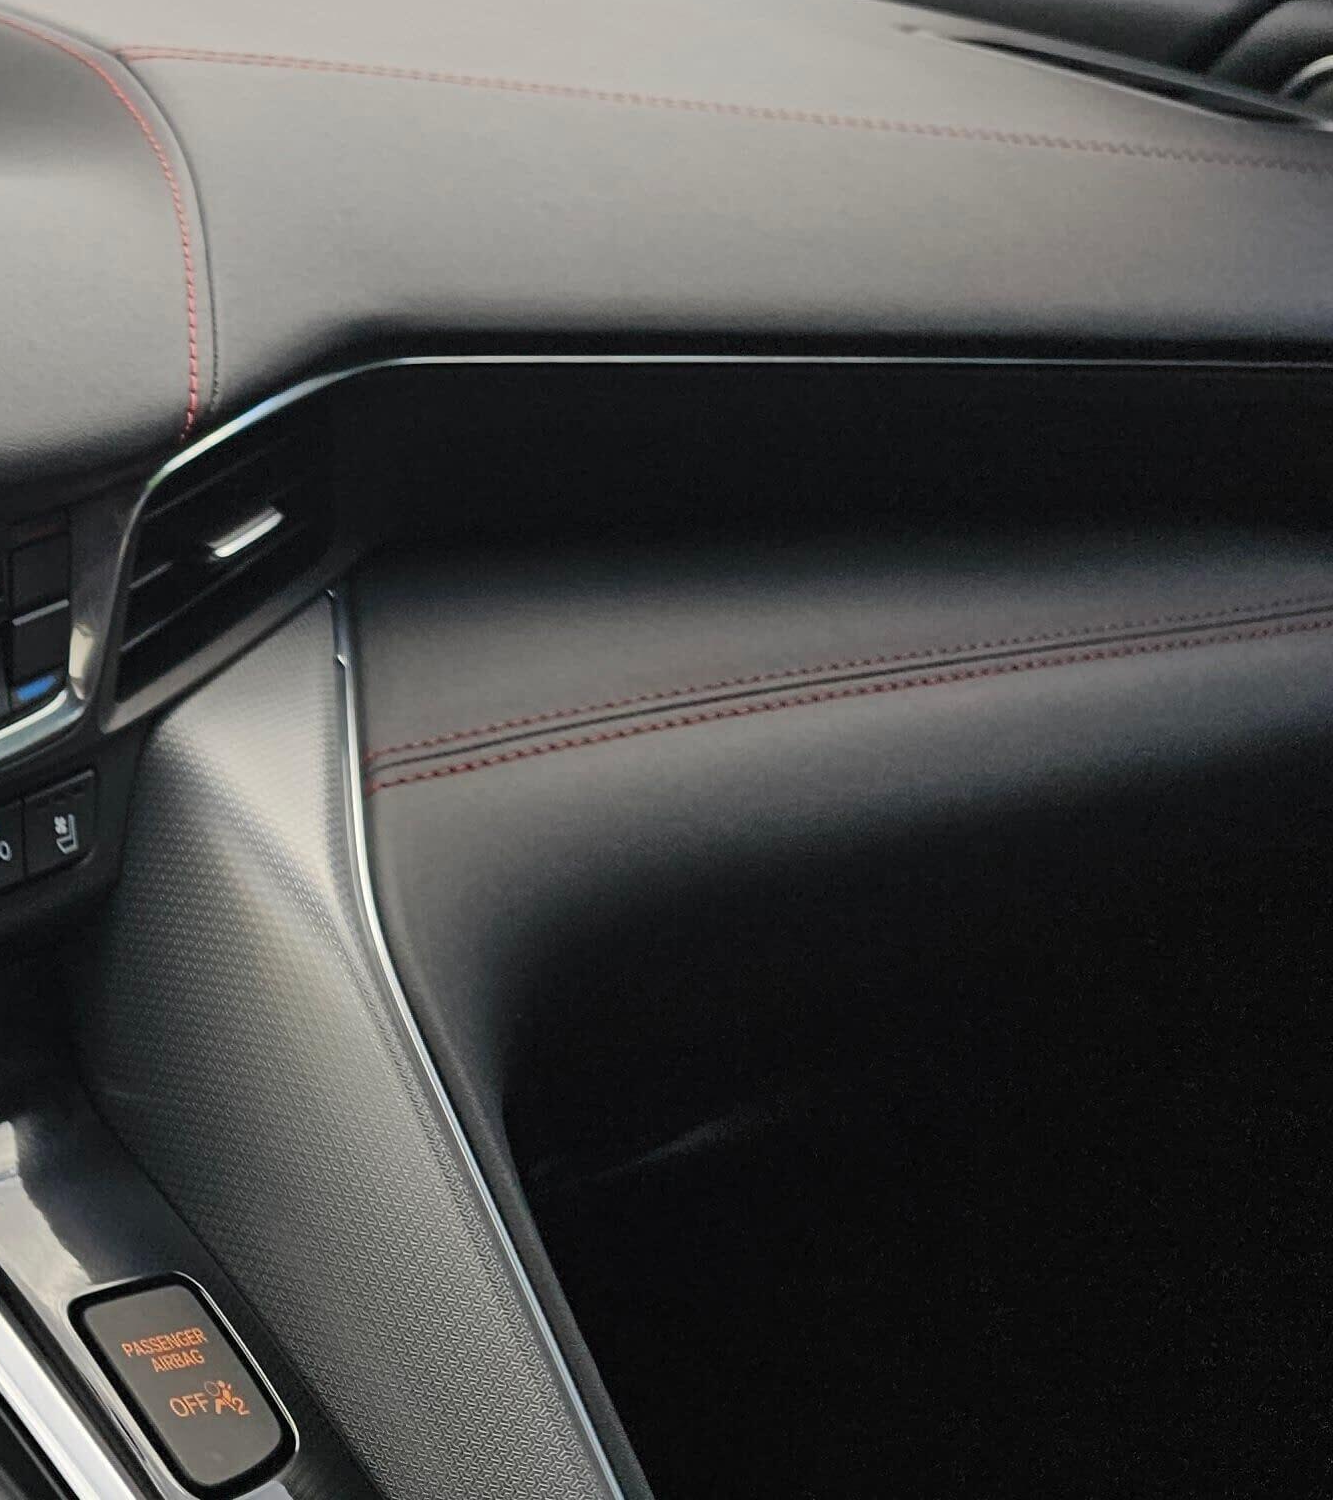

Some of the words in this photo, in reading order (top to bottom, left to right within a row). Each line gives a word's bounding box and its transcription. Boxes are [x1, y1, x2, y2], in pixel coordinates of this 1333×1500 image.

[121, 1327, 208, 1357] PASSENGER
[150, 1349, 206, 1373] AIRBAG
[169, 1392, 209, 1417] OFF
